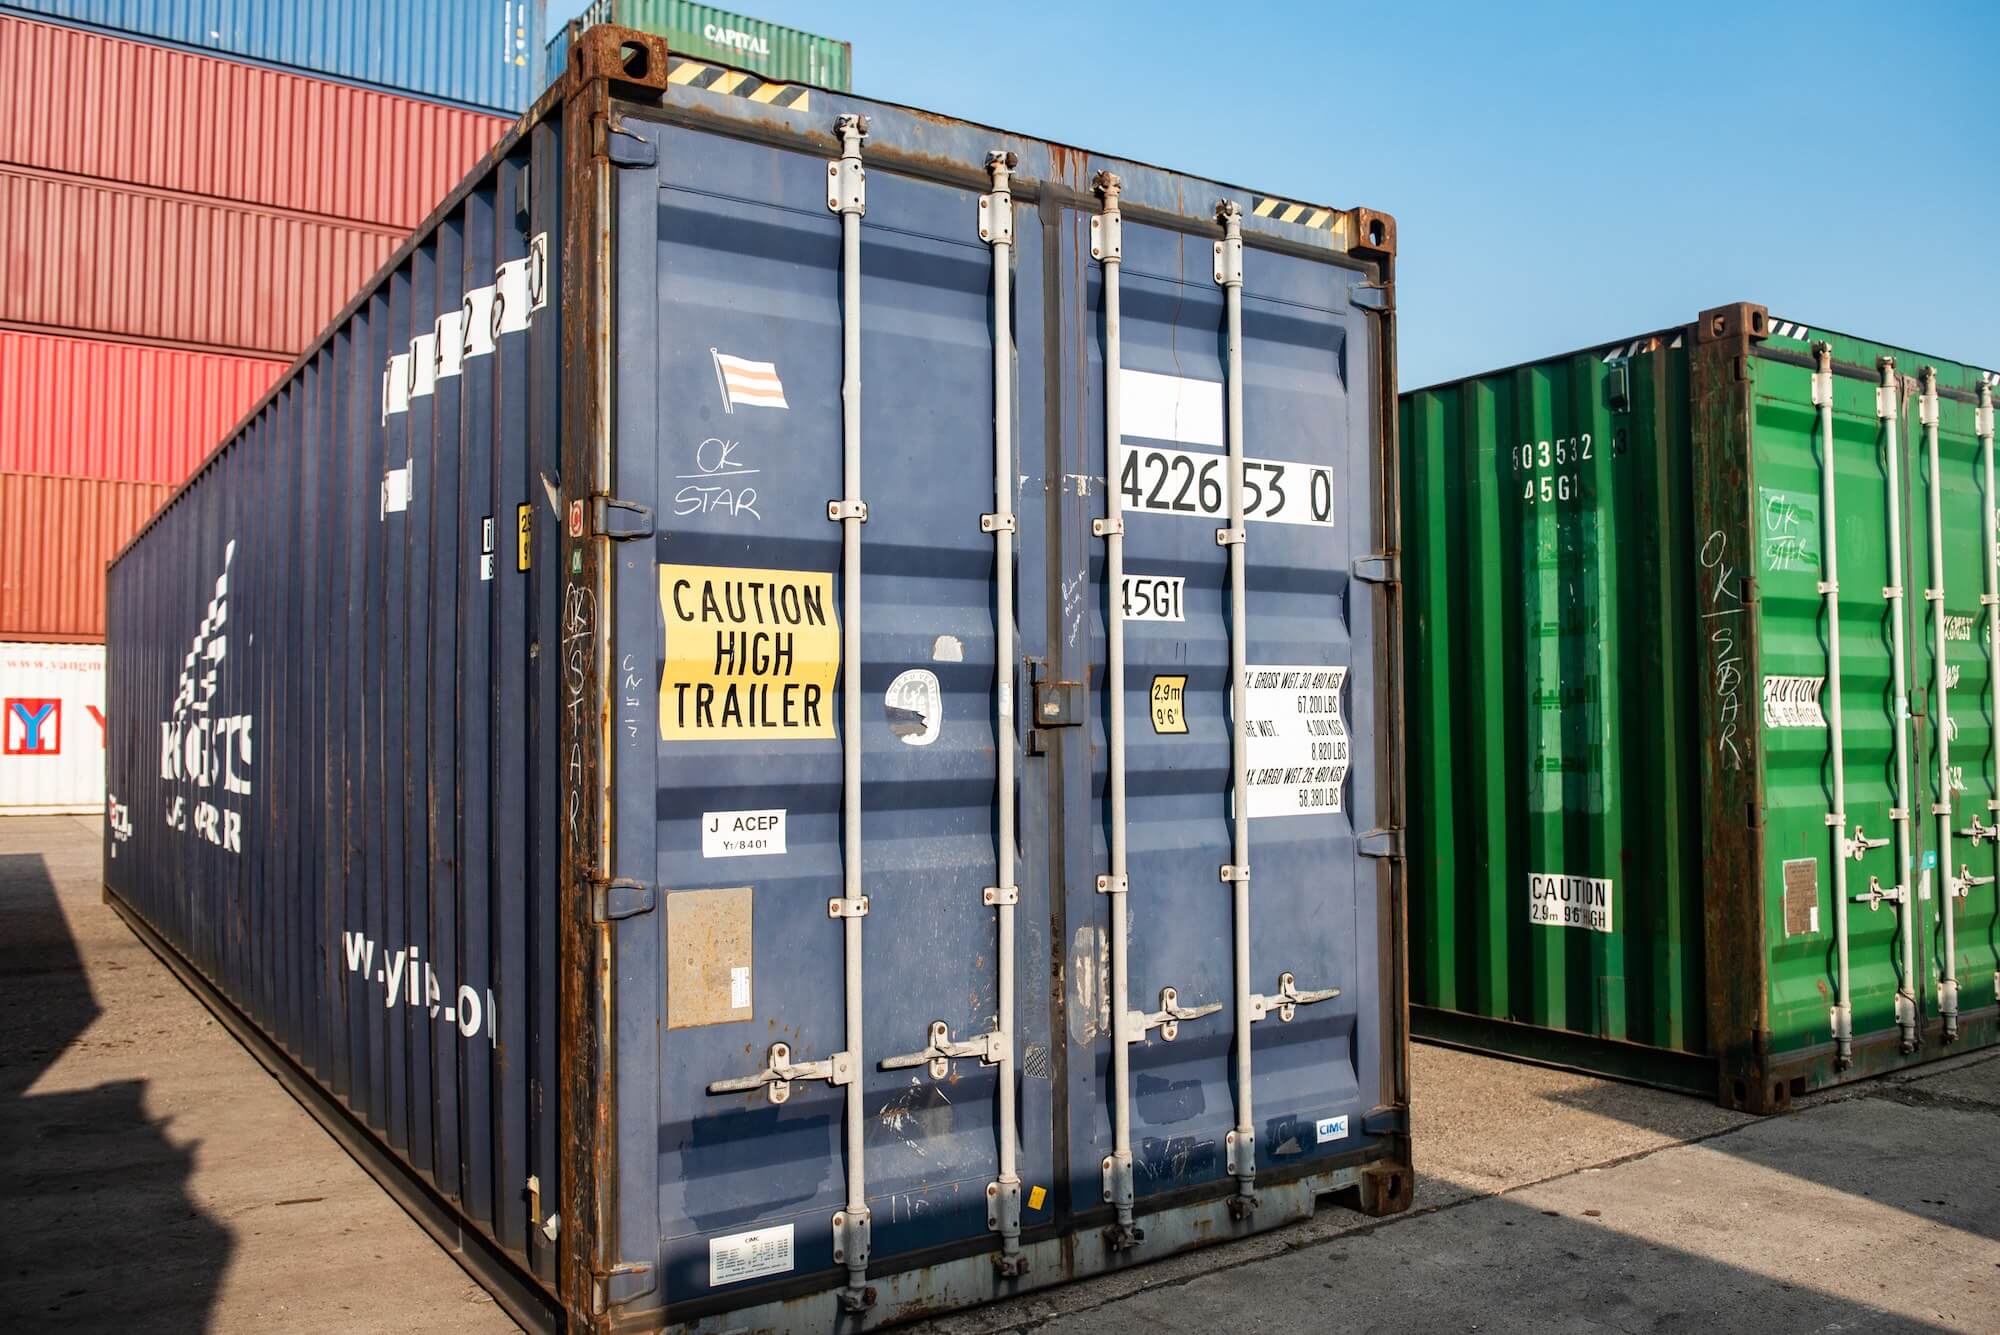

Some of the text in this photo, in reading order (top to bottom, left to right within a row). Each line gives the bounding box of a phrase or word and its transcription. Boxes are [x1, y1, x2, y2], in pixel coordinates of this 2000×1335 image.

[703, 23, 770, 54] CAPITAL
[697, 438, 742, 472] OK
[674, 486, 760, 520] STAR
[673, 579, 826, 626] CAUTION
[714, 630, 793, 677] HIGH
[1255, 672, 1281, 689] GROSS
[1763, 679, 1821, 703] CAUTION
[674, 683, 822, 729] TRAILER
[1324, 695, 1337, 714] LBS
[1328, 719, 1344, 736] KGS
[1333, 742, 1346, 760] LBS
[1257, 768, 1283, 785] CARGO
[1325, 788, 1338, 807] LBS
[710, 816, 779, 833] J ACEP
[1532, 876, 1605, 907] CAUTION
[1319, 1121, 1345, 1135] CIMC
